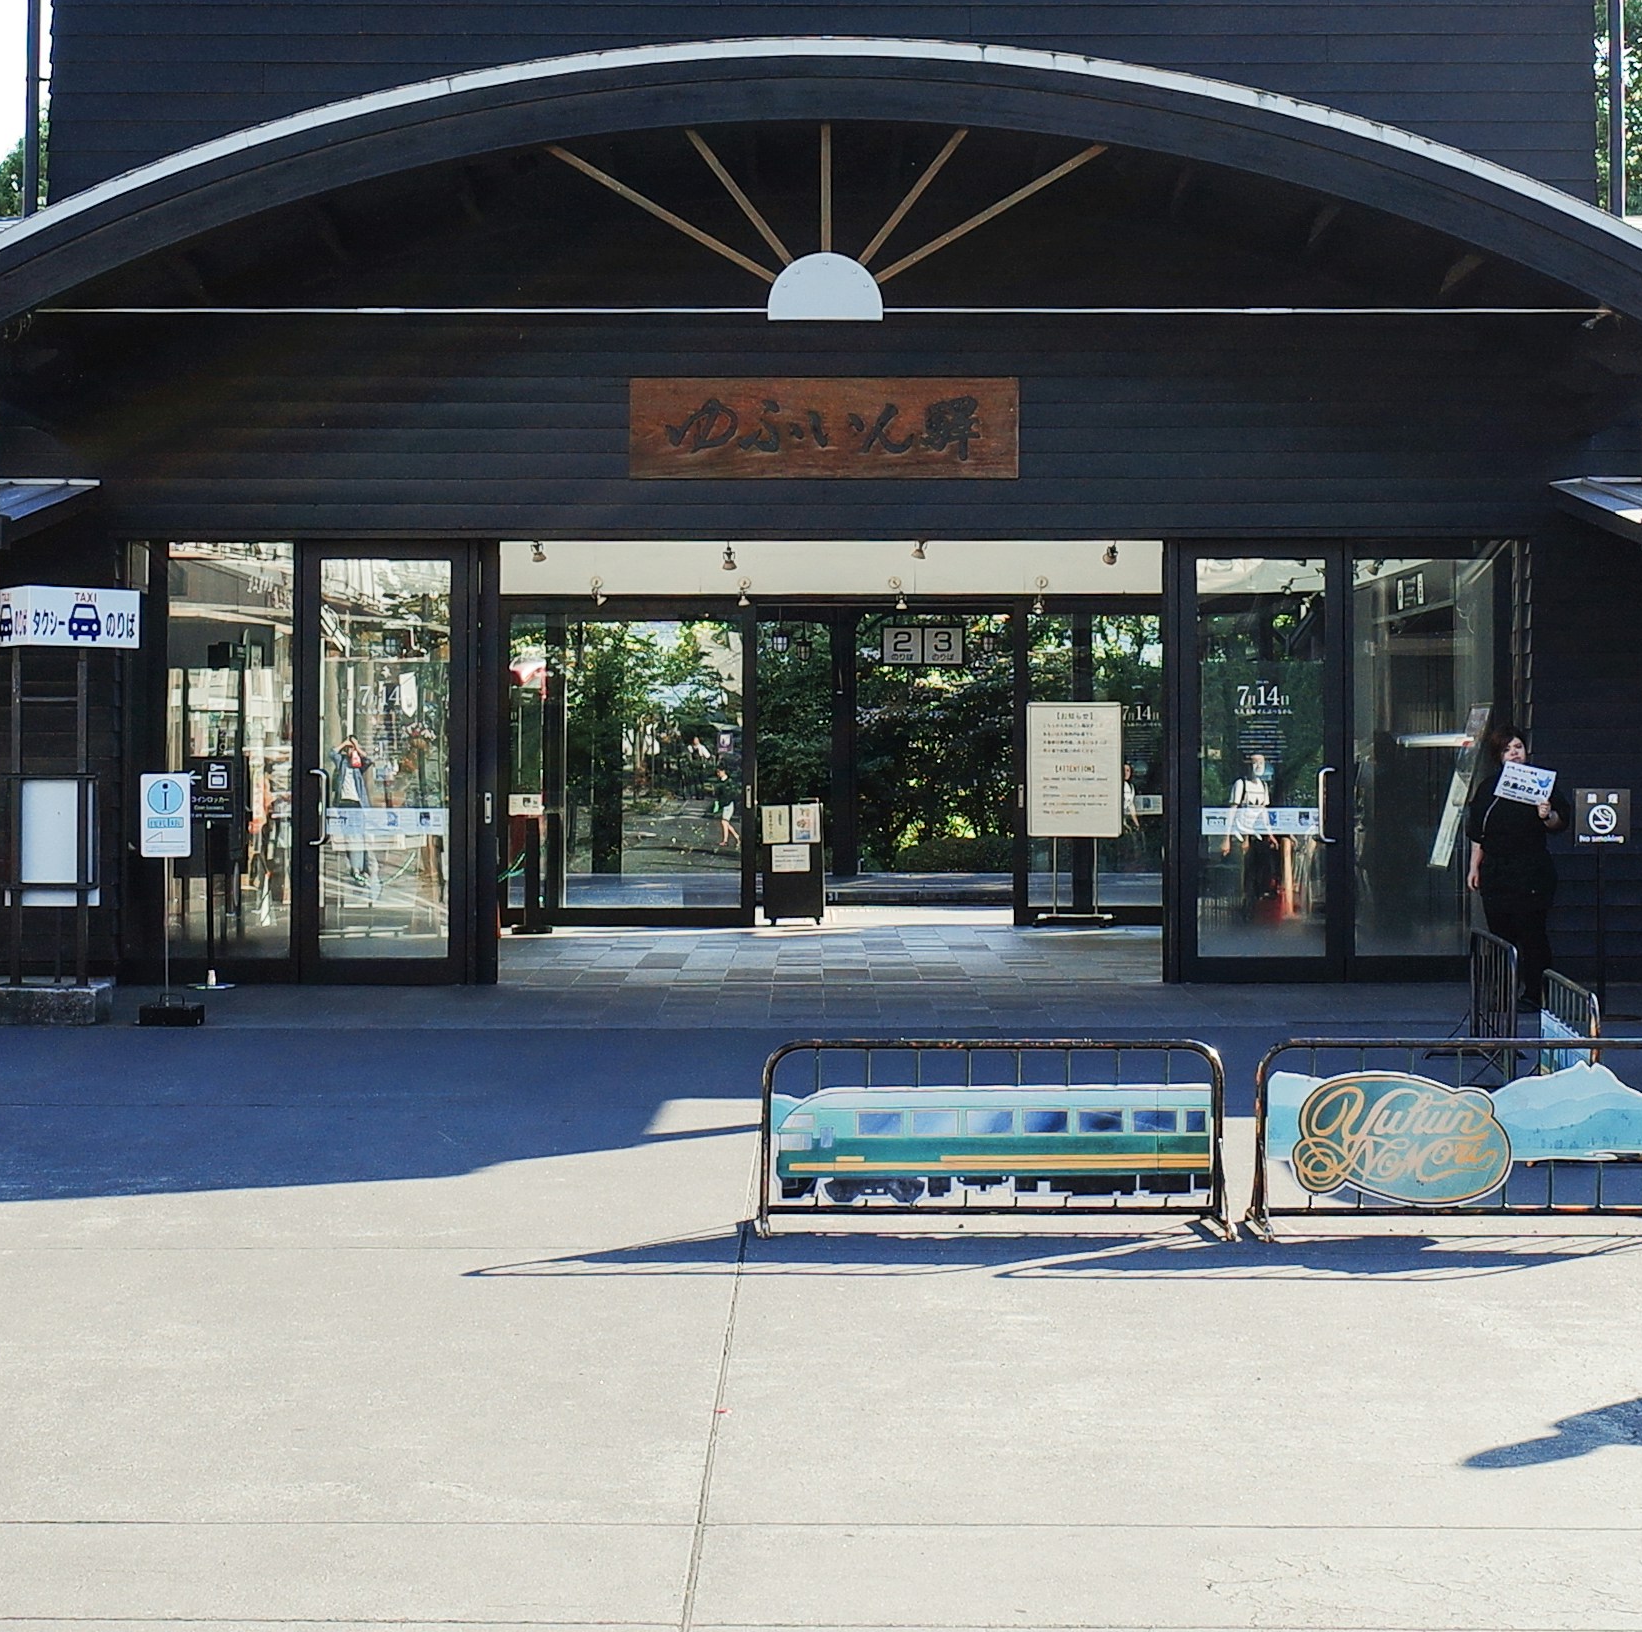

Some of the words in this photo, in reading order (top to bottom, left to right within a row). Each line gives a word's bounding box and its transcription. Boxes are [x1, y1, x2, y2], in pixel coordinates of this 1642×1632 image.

[74, 592, 97, 603] TAXI
[33, 609, 65, 636] タクシー
[106, 612, 136, 639] のりば
[893, 631, 912, 652] 2
[934, 631, 952, 652] 3
[1579, 834, 1591, 843] No
[1591, 834, 1625, 844] smoking
